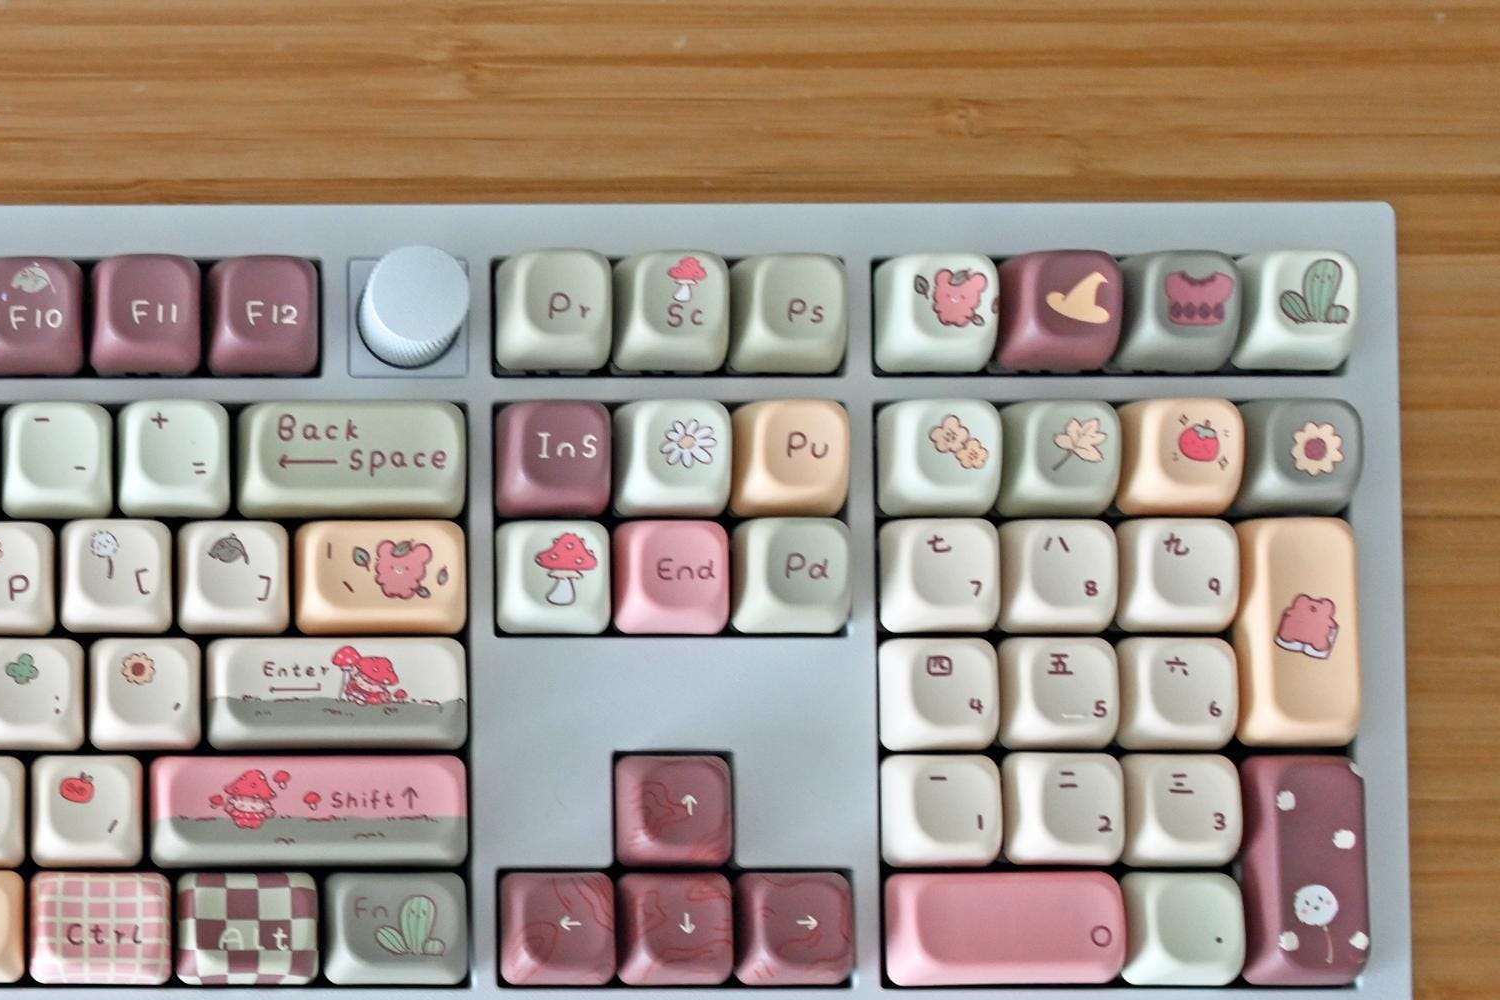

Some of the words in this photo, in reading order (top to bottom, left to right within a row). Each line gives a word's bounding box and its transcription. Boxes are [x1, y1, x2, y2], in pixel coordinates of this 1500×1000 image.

[10, 306, 63, 329] F10
[132, 301, 177, 324] F11
[247, 301, 298, 325] F12
[548, 292, 591, 320] Pr
[667, 303, 705, 329] Sc
[788, 298, 824, 326] Ps
[150, 413, 168, 429] +
[277, 413, 360, 441] Back
[788, 431, 829, 459] Pu
[656, 558, 715, 584] End
[785, 552, 829, 581] Pd
[9, 575, 30, 601] P
[969, 580, 982, 597] 7
[1084, 580, 1098, 597] 8
[1208, 578, 1221, 596] 9
[263, 661, 331, 678] Enter
[1047, 653, 1073, 676] 五
[1165, 656, 1189, 676] 六
[968, 698, 982, 715] 4
[1093, 701, 1107, 719] 5
[1209, 701, 1221, 717] 6
[331, 788, 396, 810] Shift
[1097, 815, 1112, 833] 2
[1212, 812, 1227, 831] 3
[355, 897, 388, 921] Fn
[67, 922, 142, 946] Ctrl
[217, 926, 293, 951] Alt
